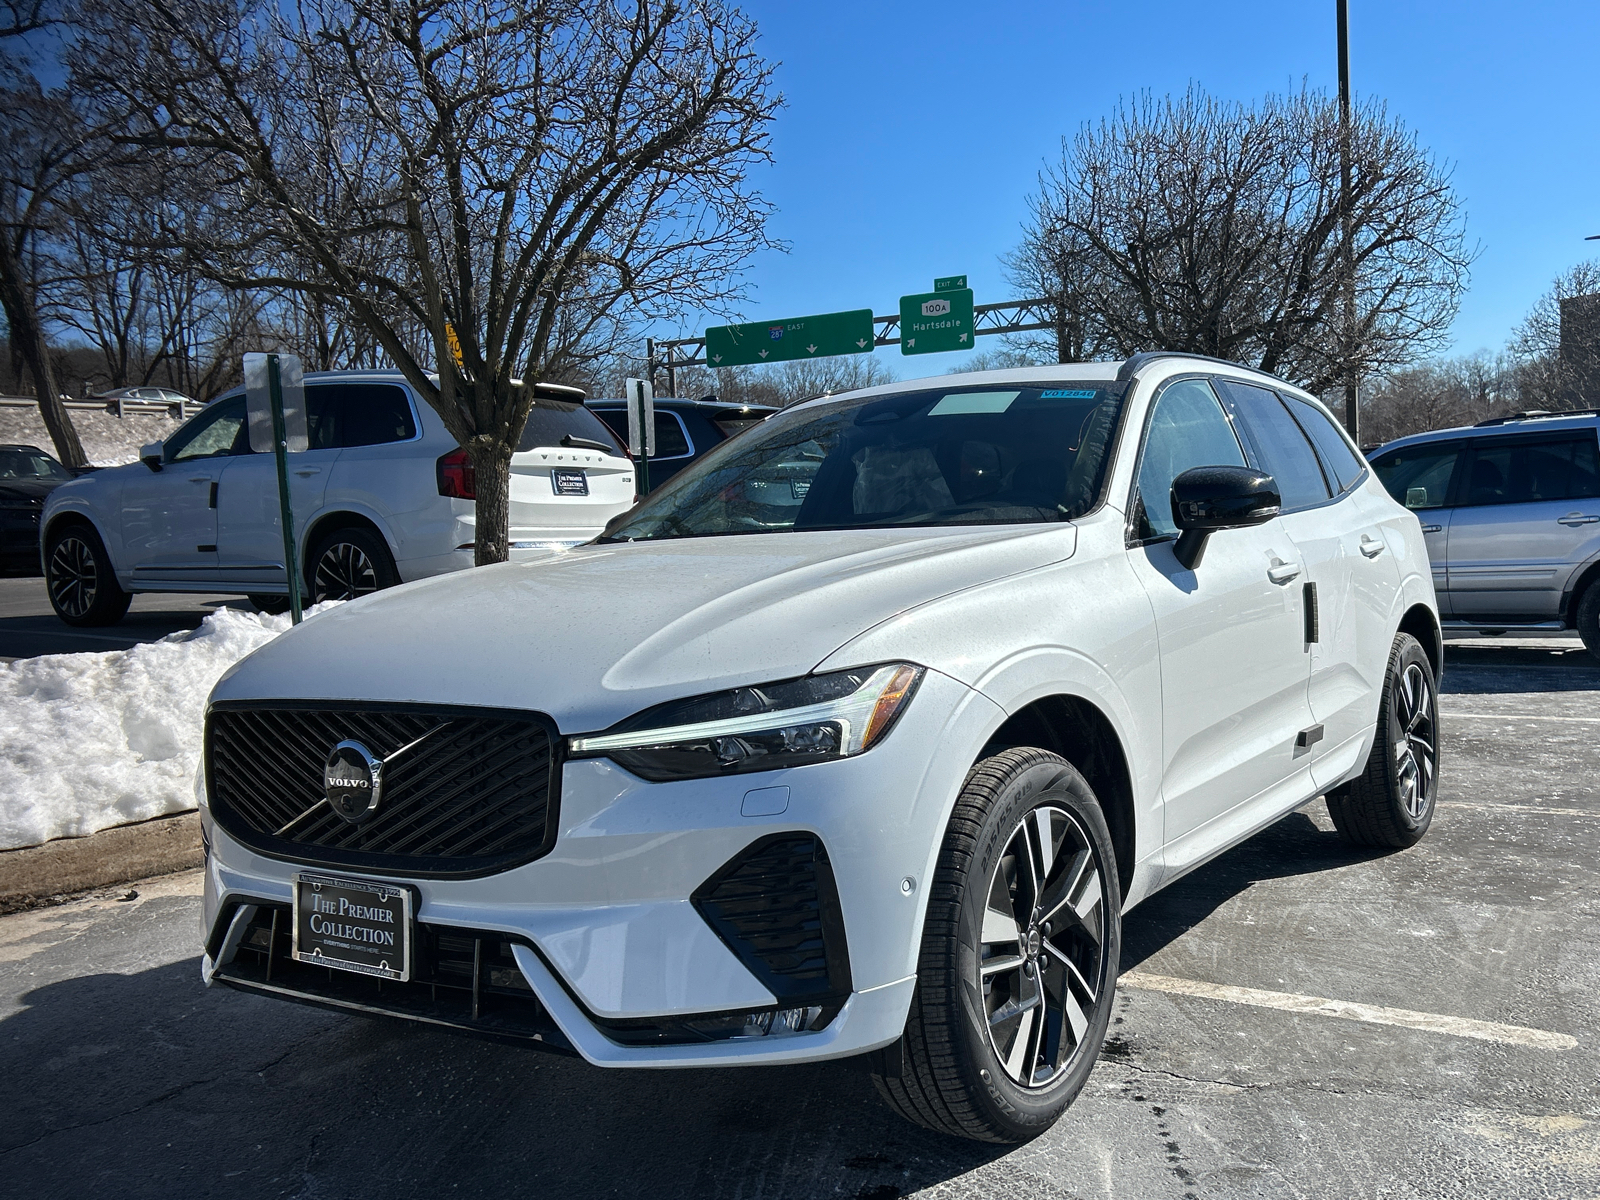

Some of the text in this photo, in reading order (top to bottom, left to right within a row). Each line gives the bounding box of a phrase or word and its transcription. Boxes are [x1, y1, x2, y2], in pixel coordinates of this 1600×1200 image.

[956, 278, 964, 286] 4
[925, 304, 947, 313] 100A
[787, 323, 805, 331] EAST
[912, 319, 962, 332] Hartsdale
[770, 330, 784, 339] 287
[1044, 390, 1094, 398] V012846
[328, 777, 369, 788] VOLVO
[1014, 780, 1033, 806] R19
[311, 893, 395, 924] THE PREMIER
[309, 913, 395, 946] COLLECTION
[980, 1069, 1016, 1117] ZERO
